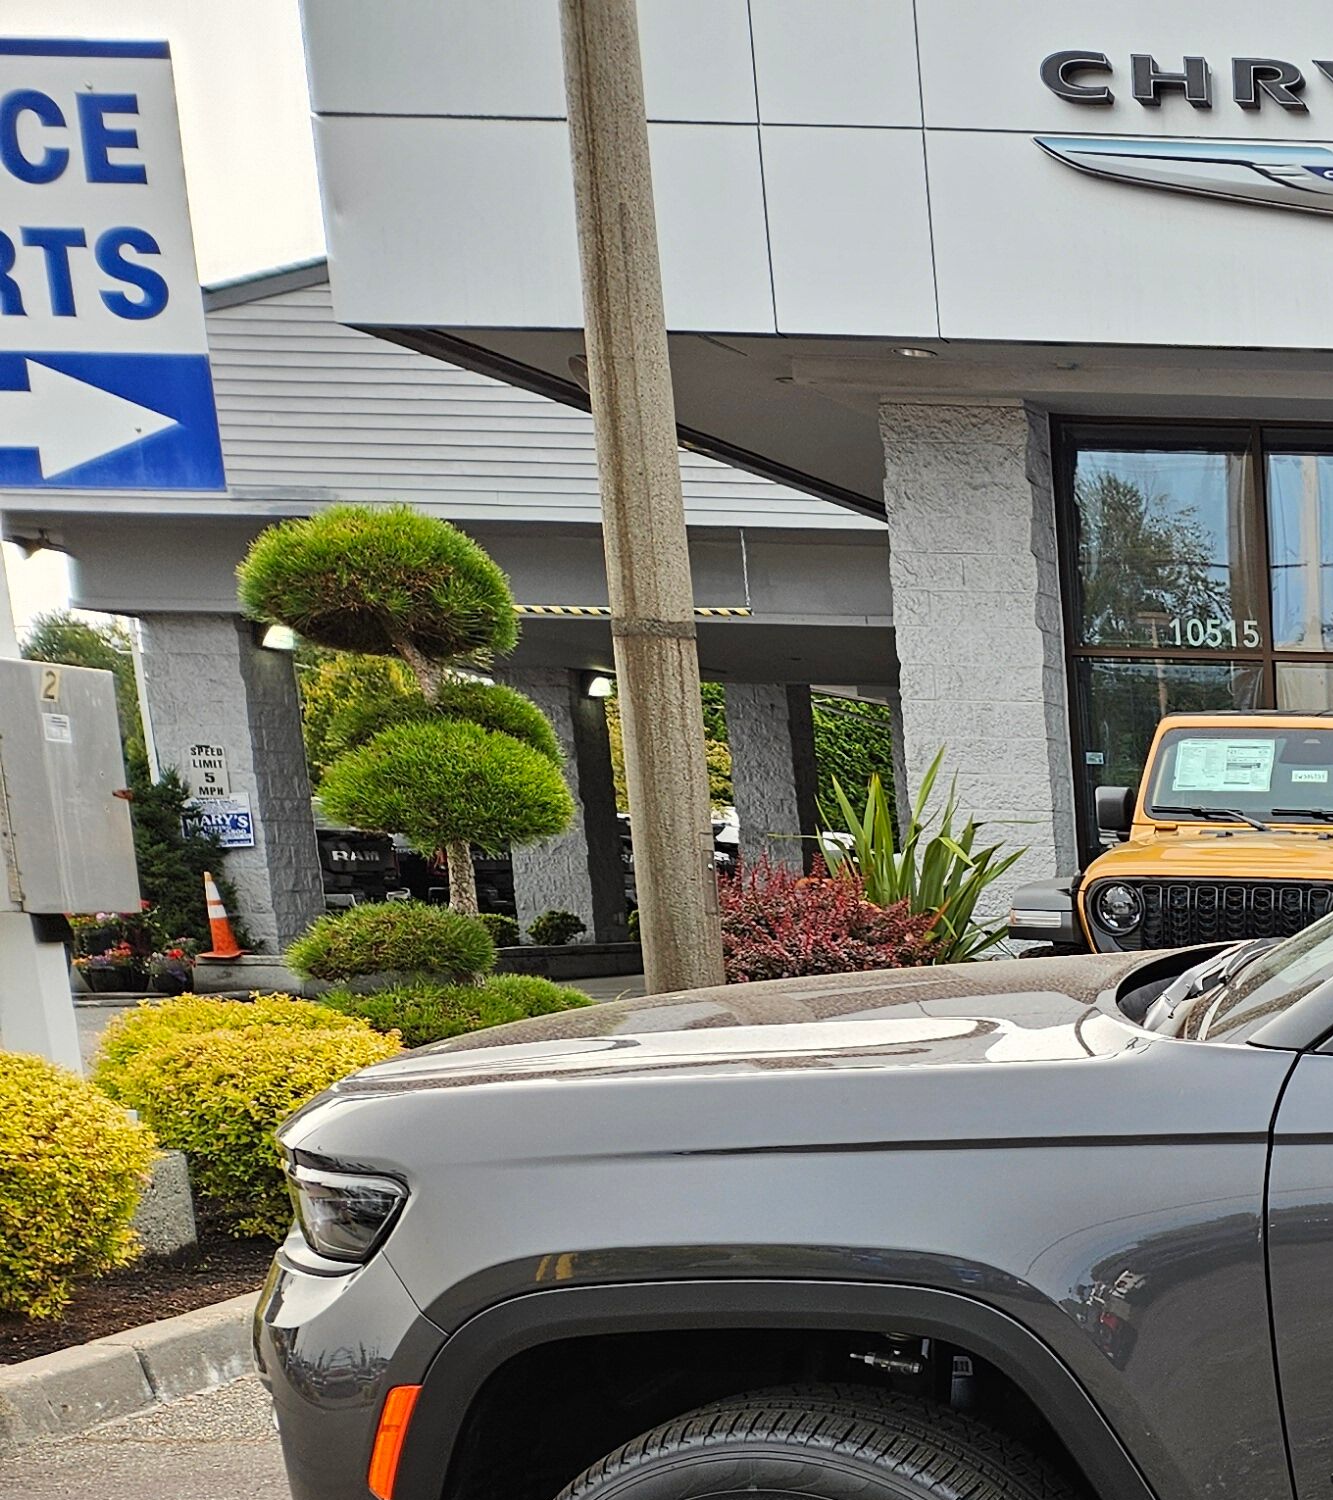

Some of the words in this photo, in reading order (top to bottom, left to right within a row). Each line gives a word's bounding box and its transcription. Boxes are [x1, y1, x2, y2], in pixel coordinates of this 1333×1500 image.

[0, 87, 148, 185] CE
[0, 226, 170, 321] TS
[1168, 617, 1260, 648] 10515
[43, 670, 57, 699] 2
[190, 746, 224, 757] SPEED
[192, 759, 224, 769] LIMIT
[204, 772, 216, 783] 5
[198, 786, 225, 796] MPH
[331, 850, 380, 861] RAM
